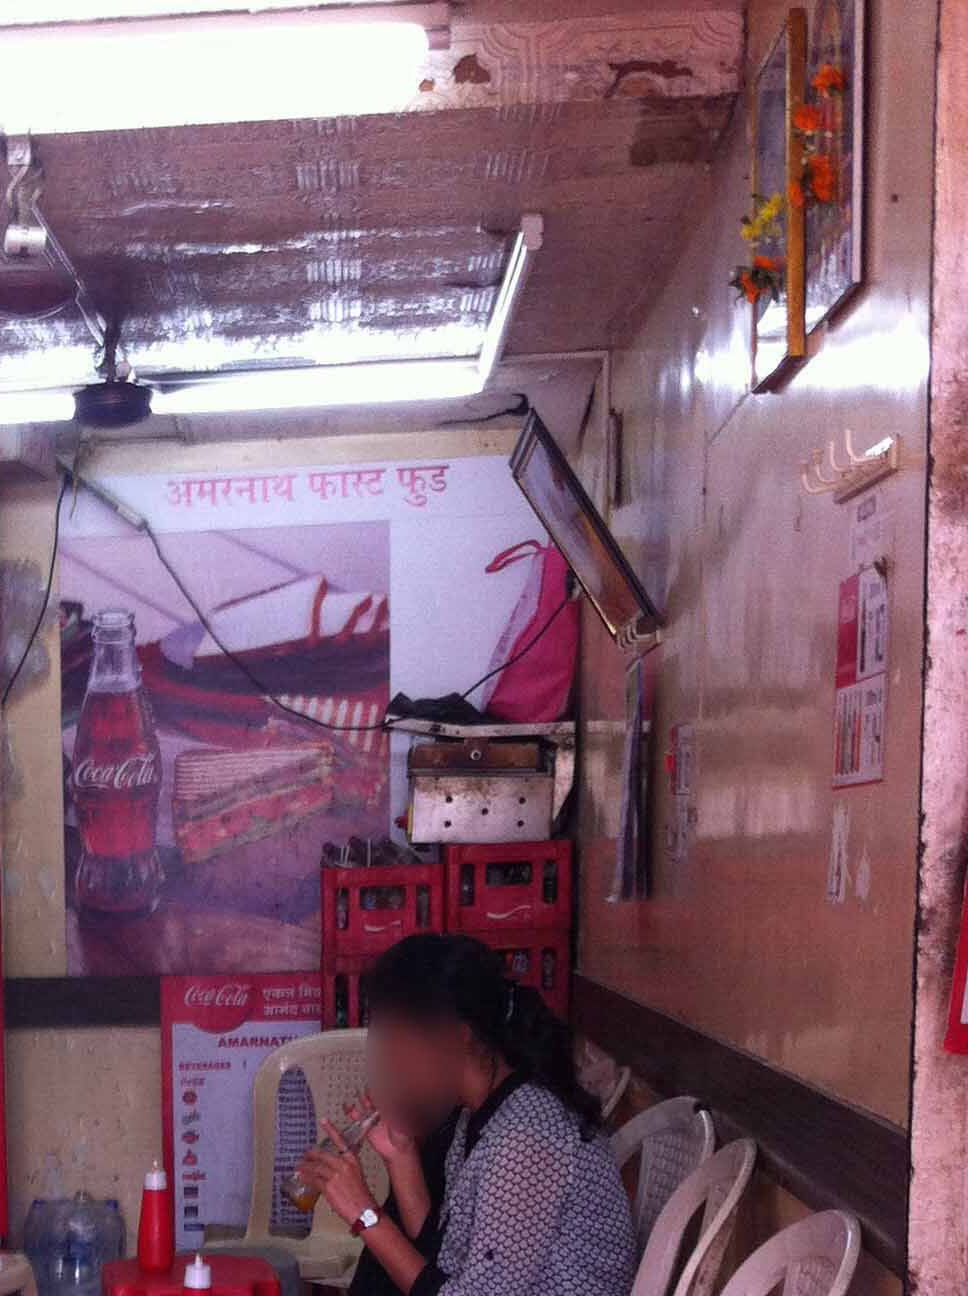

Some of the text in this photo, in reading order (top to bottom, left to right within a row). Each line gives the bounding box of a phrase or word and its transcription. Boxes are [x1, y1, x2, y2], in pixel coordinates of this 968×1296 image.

[167, 464, 450, 507] अमरनाथ फास्ट फुड
[74, 752, 156, 789] Coca-Cola
[184, 984, 249, 1007] Coca-Cola
[218, 1034, 298, 1048] AMARNAT
